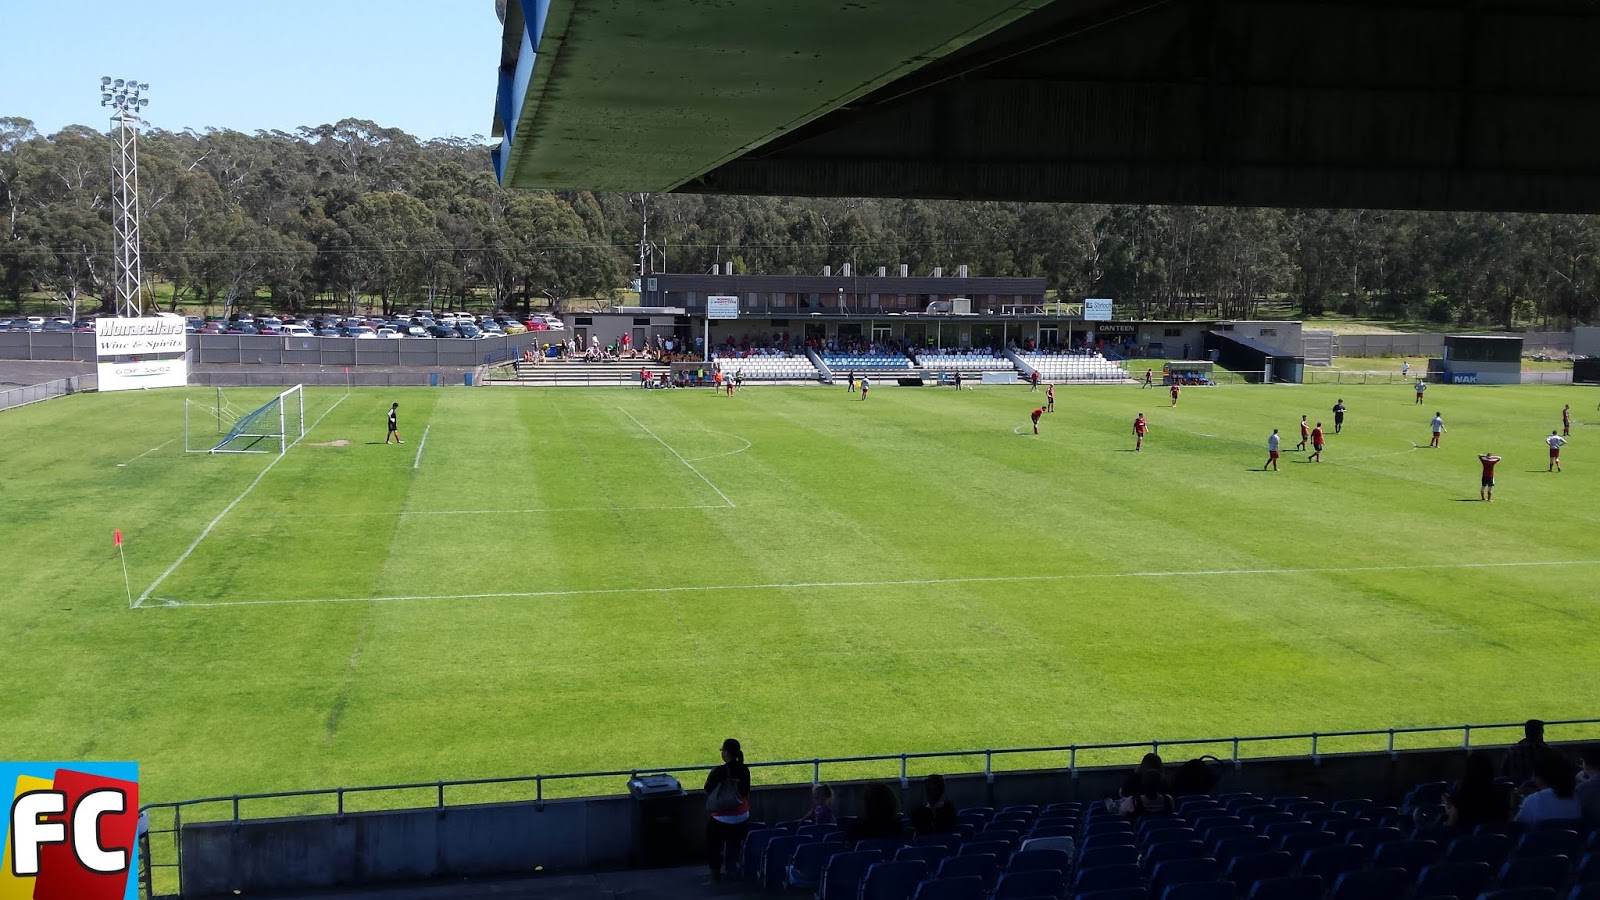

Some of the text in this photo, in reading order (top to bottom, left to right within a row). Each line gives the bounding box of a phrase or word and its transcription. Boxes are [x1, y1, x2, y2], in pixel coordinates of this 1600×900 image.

[101, 339, 183, 350] Wine & Spirits
[1454, 375, 1477, 383] NAK
